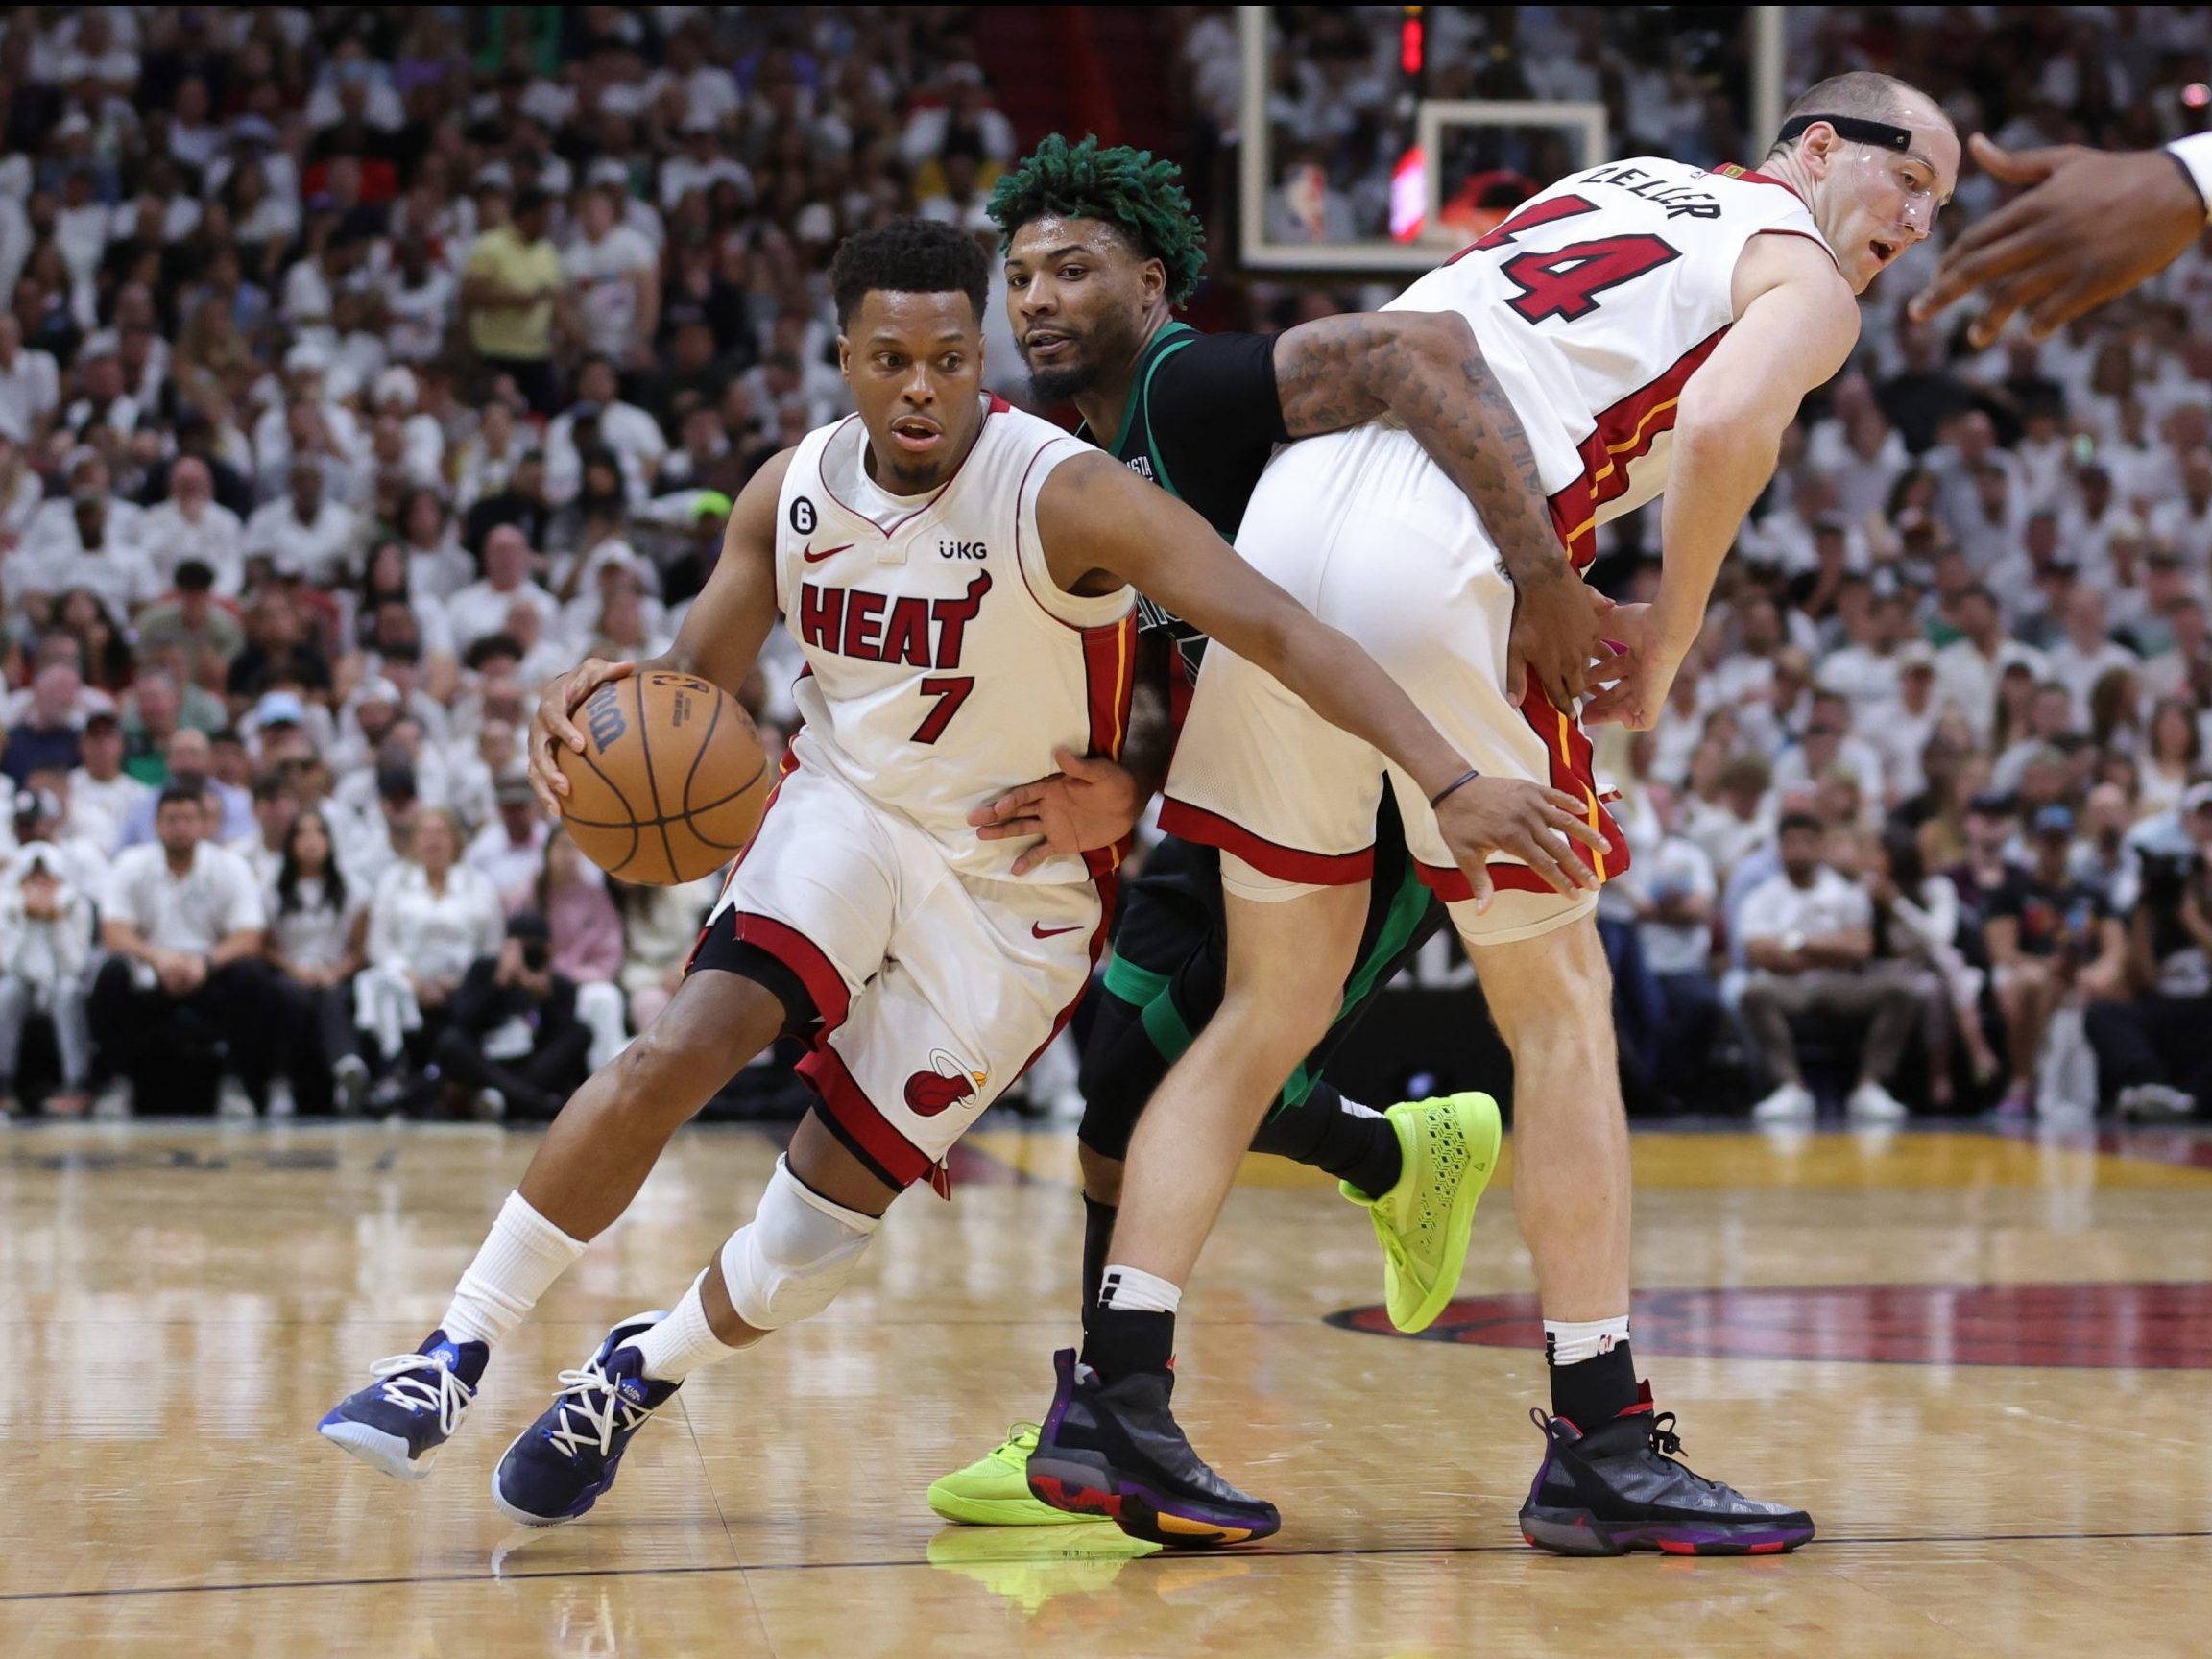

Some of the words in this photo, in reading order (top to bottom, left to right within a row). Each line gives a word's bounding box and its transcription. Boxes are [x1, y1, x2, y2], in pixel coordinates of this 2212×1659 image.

[1577, 166, 1722, 221] ZELLER
[795, 501, 812, 531] 6
[799, 567, 994, 670] HEAT
[910, 676, 975, 745] 7
